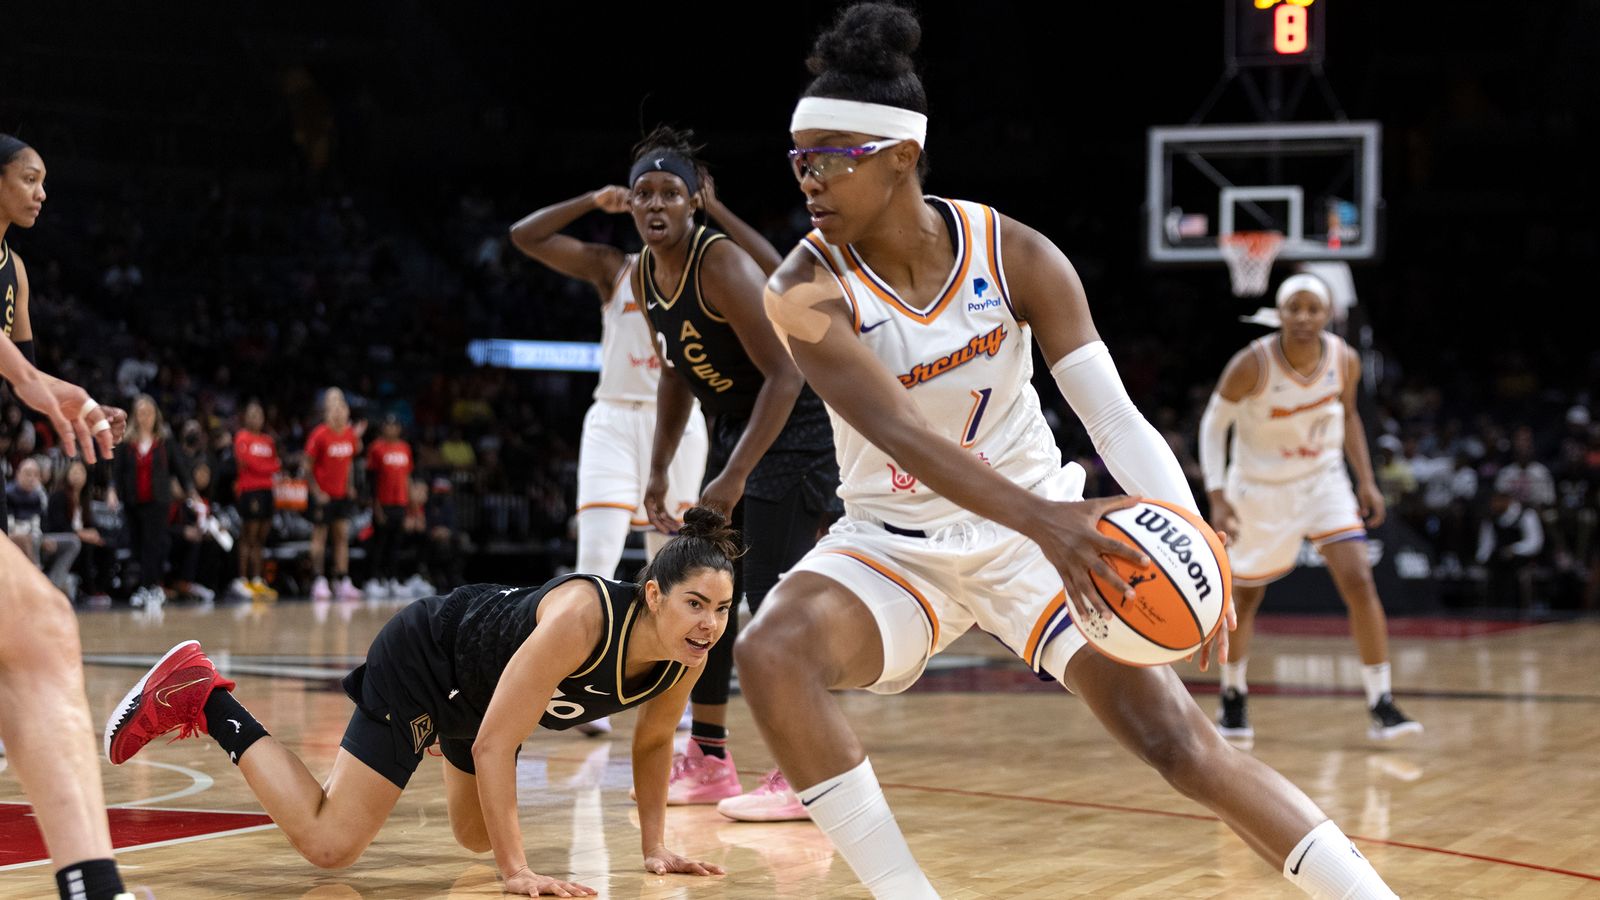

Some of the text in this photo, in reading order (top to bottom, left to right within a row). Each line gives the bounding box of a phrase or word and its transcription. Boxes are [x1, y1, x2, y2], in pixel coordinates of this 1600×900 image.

[1274, 4, 1308, 54] 8
[5, 284, 14, 338] ACE
[967, 297, 1002, 312] PayPal
[680, 319, 734, 393] ACES
[897, 323, 1008, 390] ercury
[1135, 507, 1212, 602] Wilson
